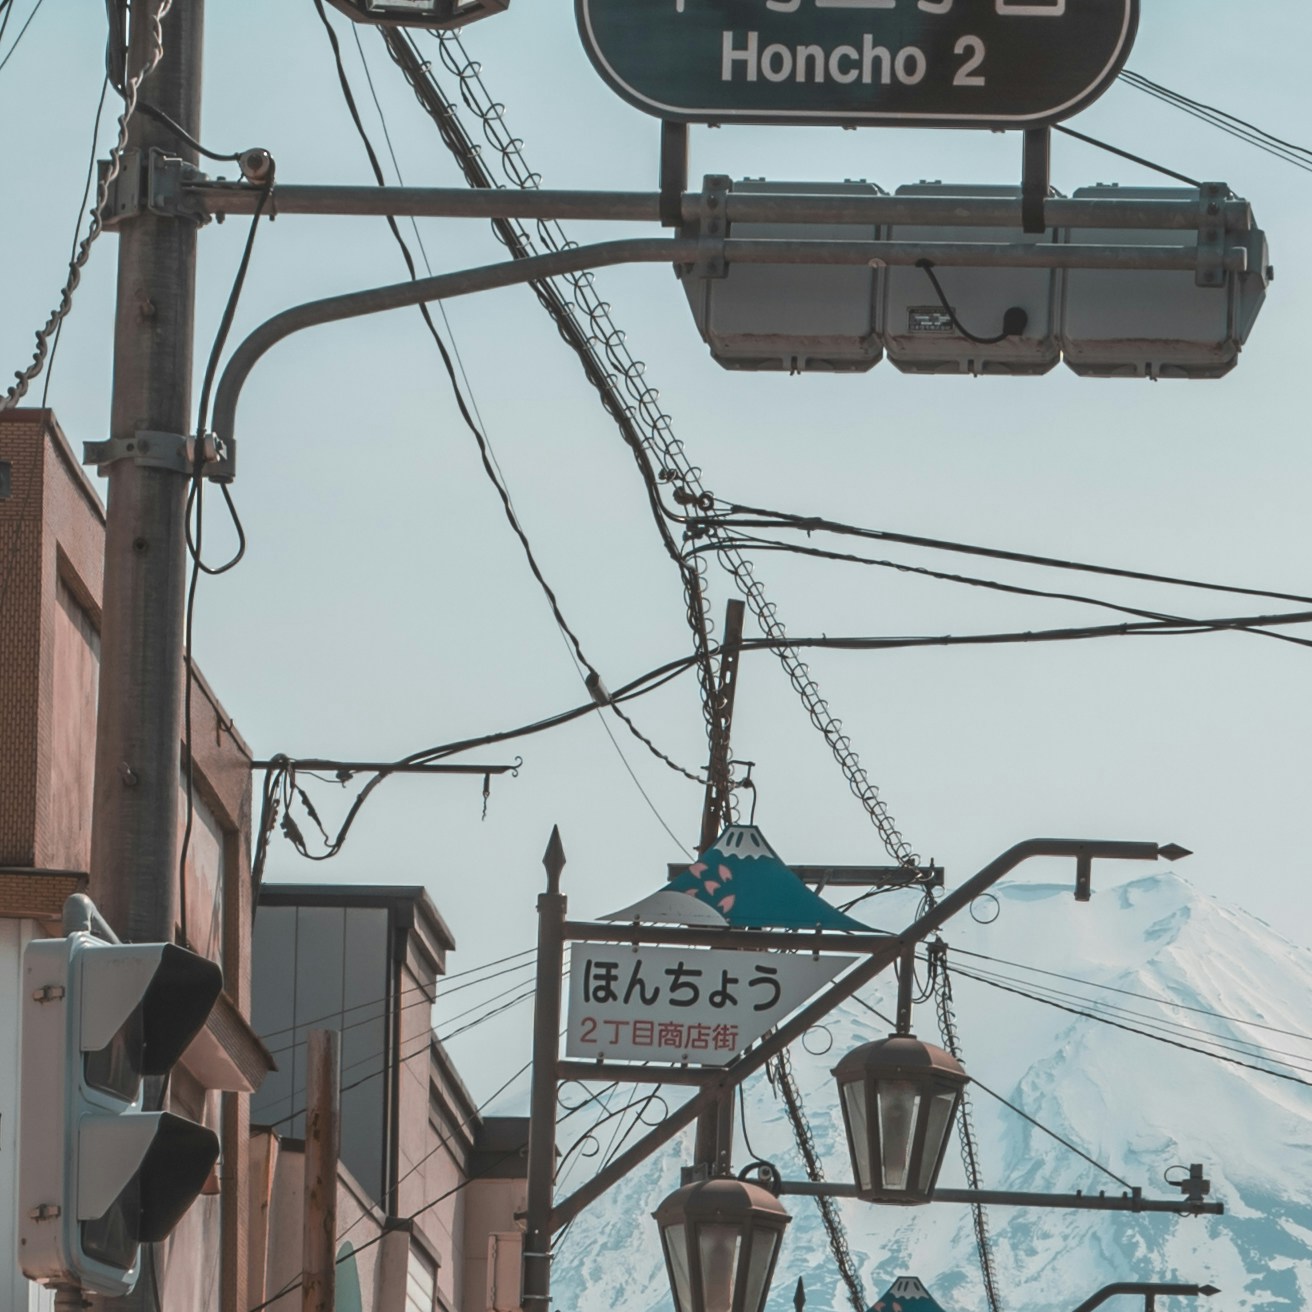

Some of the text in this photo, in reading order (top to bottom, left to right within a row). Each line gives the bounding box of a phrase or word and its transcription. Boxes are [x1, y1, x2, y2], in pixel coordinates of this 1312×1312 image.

[722, 31, 986, 86] Honcho 2
[583, 958, 781, 1012] ほんちょう
[580, 1016, 739, 1051] 2丁目商店街
